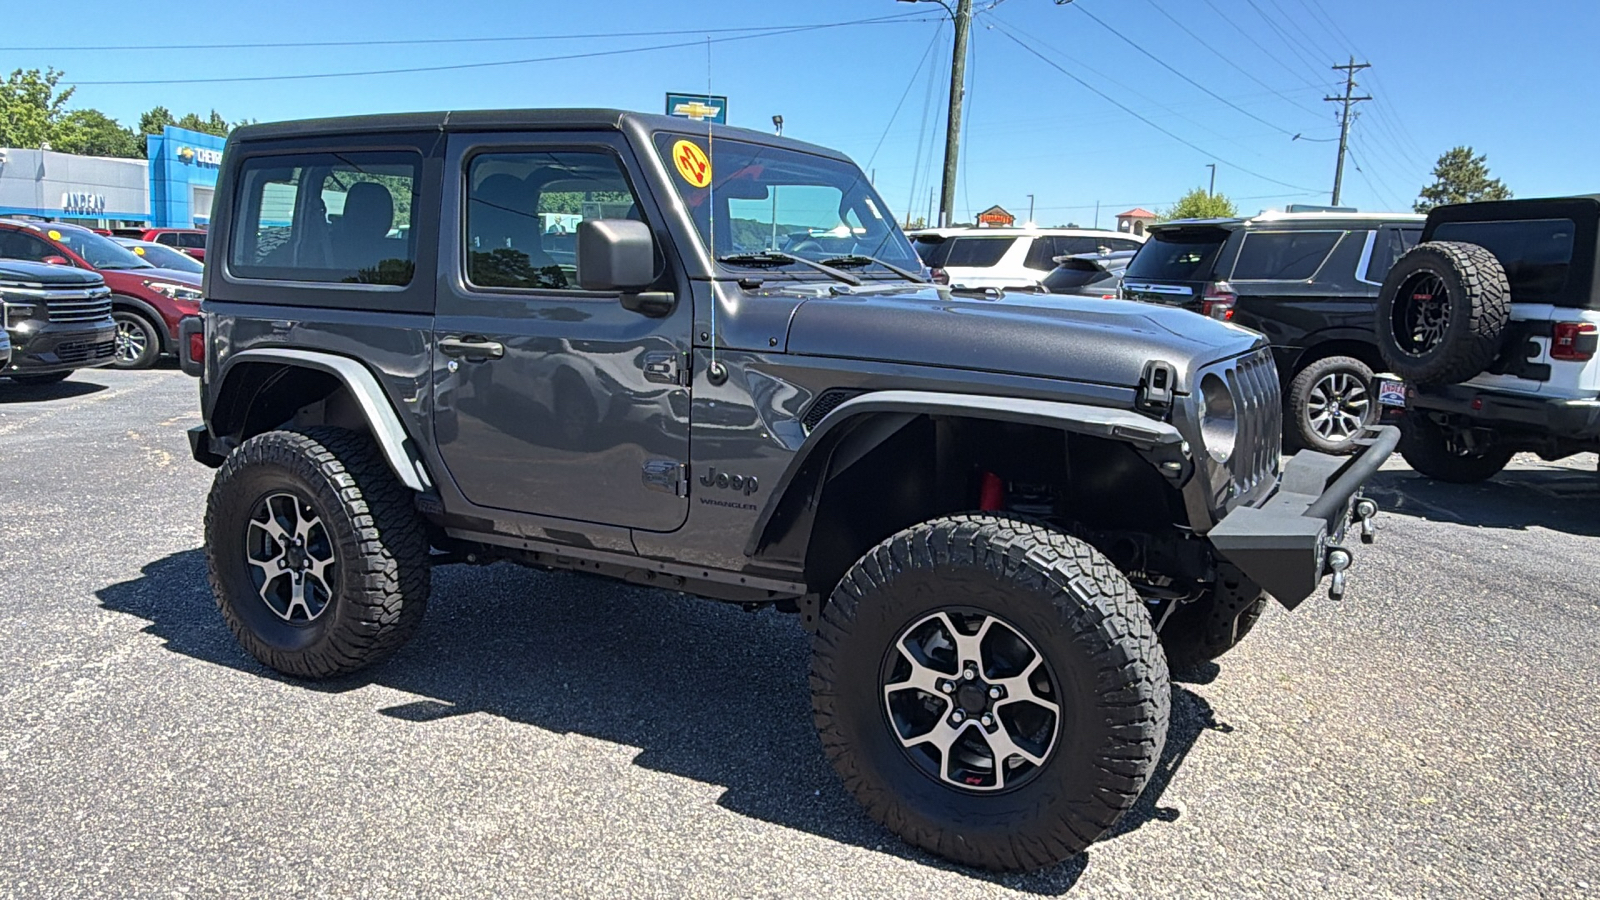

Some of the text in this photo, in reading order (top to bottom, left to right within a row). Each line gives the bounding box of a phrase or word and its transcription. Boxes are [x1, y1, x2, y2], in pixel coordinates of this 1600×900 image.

[679, 145, 706, 184] 22
[61, 192, 105, 209] ANDEAN
[700, 466, 759, 496] Jeep
[700, 498, 758, 511] WRANGLER
